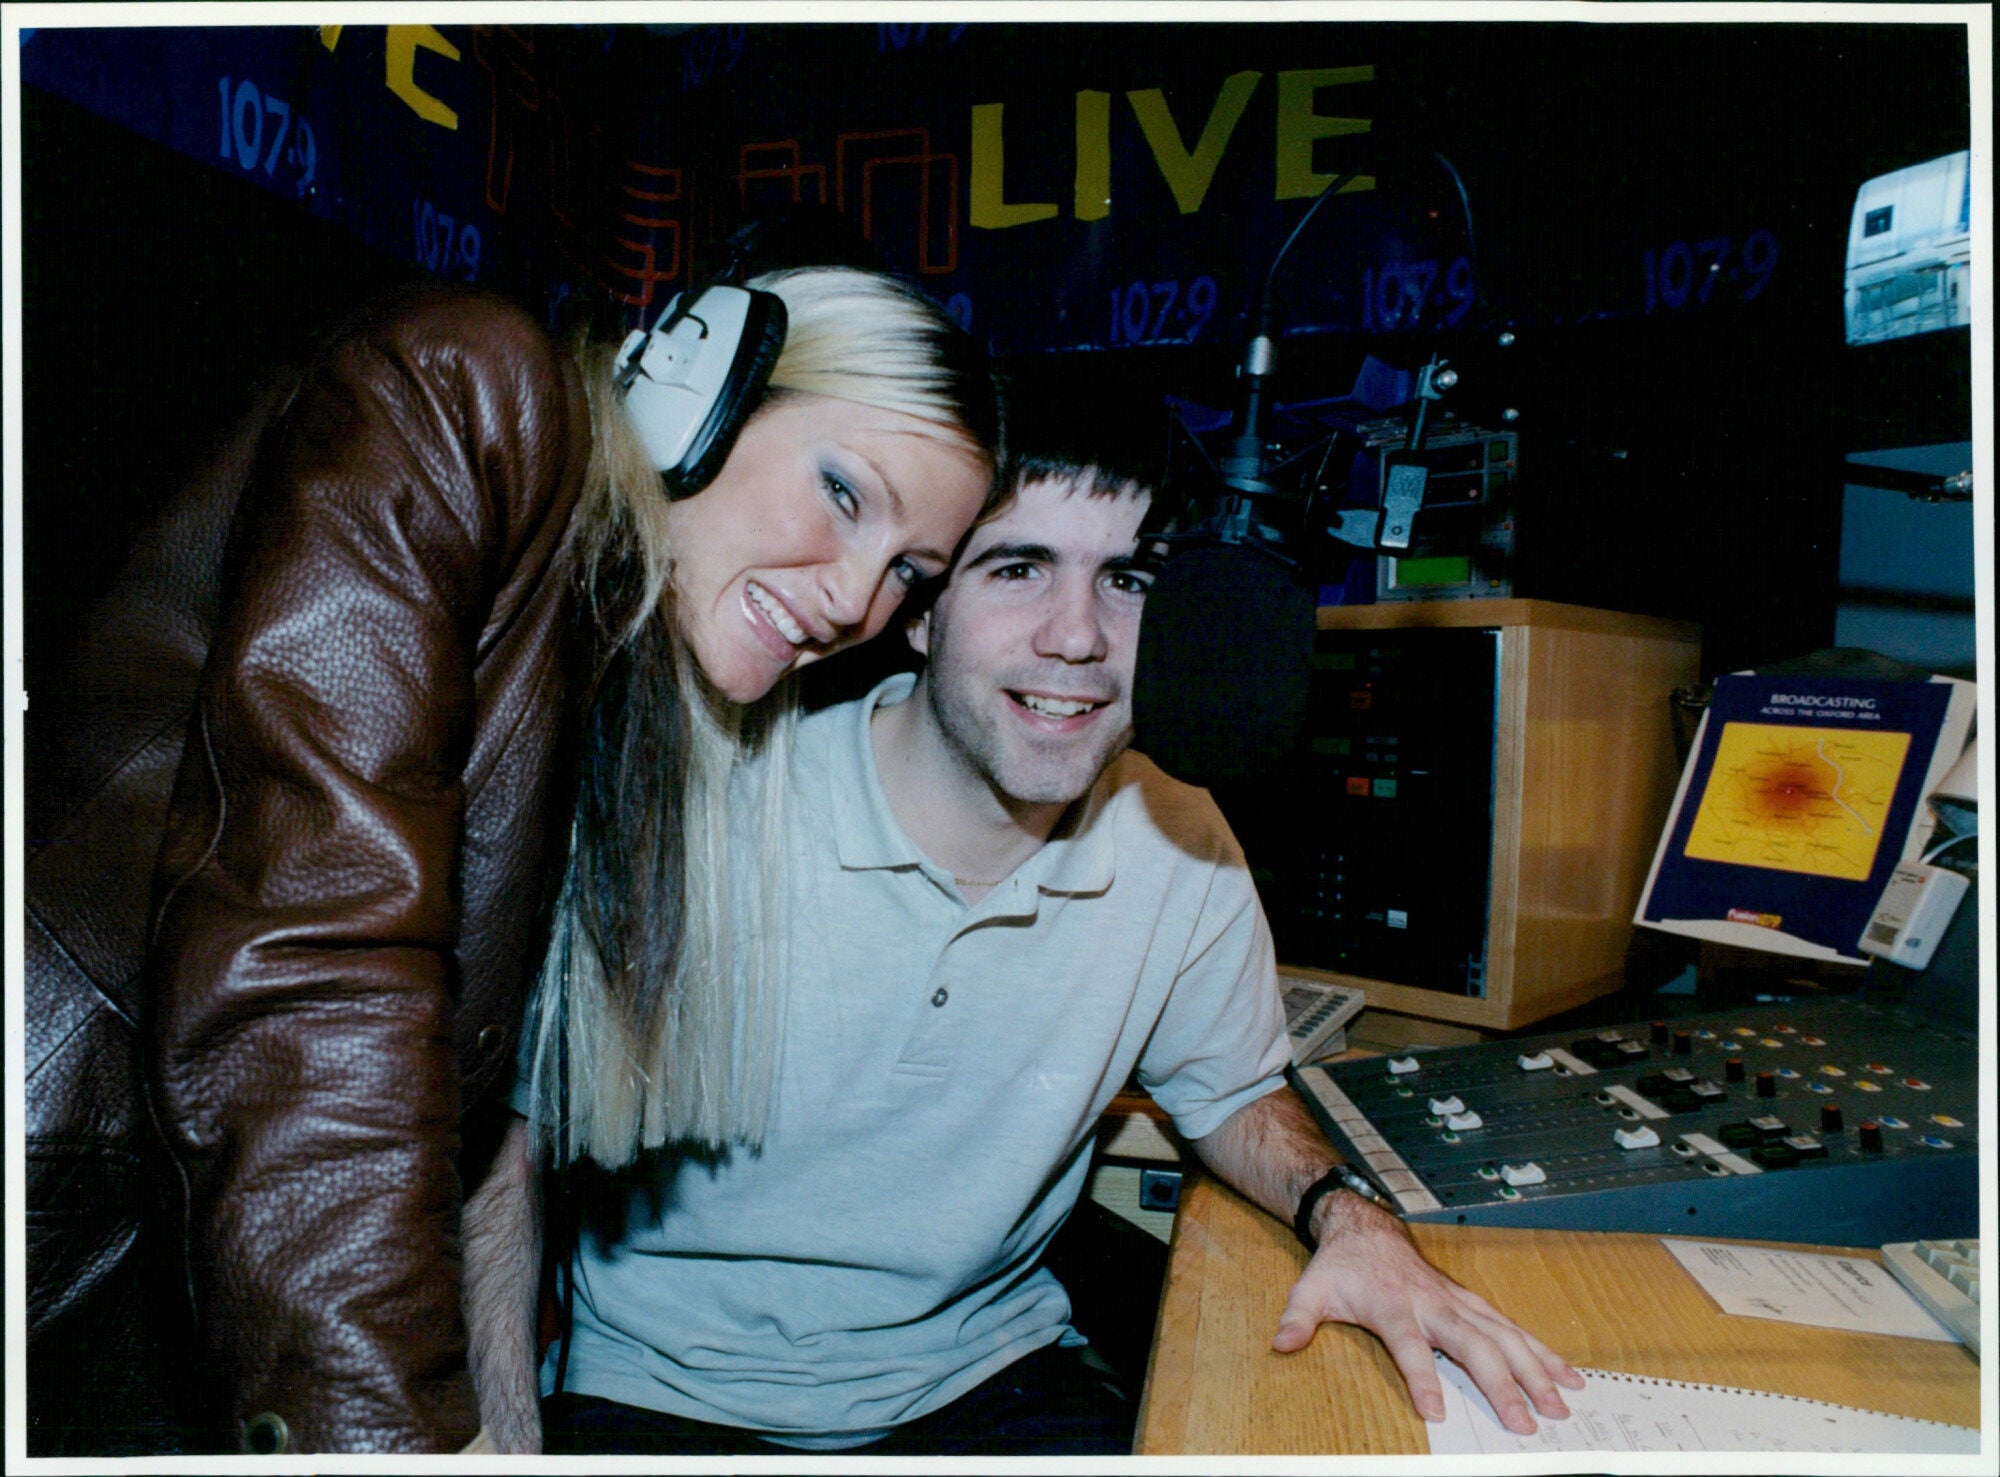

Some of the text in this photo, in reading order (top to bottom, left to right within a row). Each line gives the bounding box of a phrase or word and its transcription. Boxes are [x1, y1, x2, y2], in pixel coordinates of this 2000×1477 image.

[218, 75, 316, 199] 107.9
[970, 66, 1377, 229] LIVE
[413, 197, 481, 282] 107.9
[1643, 229, 1779, 314] 107.9
[1110, 276, 1218, 346] 107.9
[1362, 256, 1475, 330] 107.9
[1770, 694, 1876, 709] BROADCASTING
